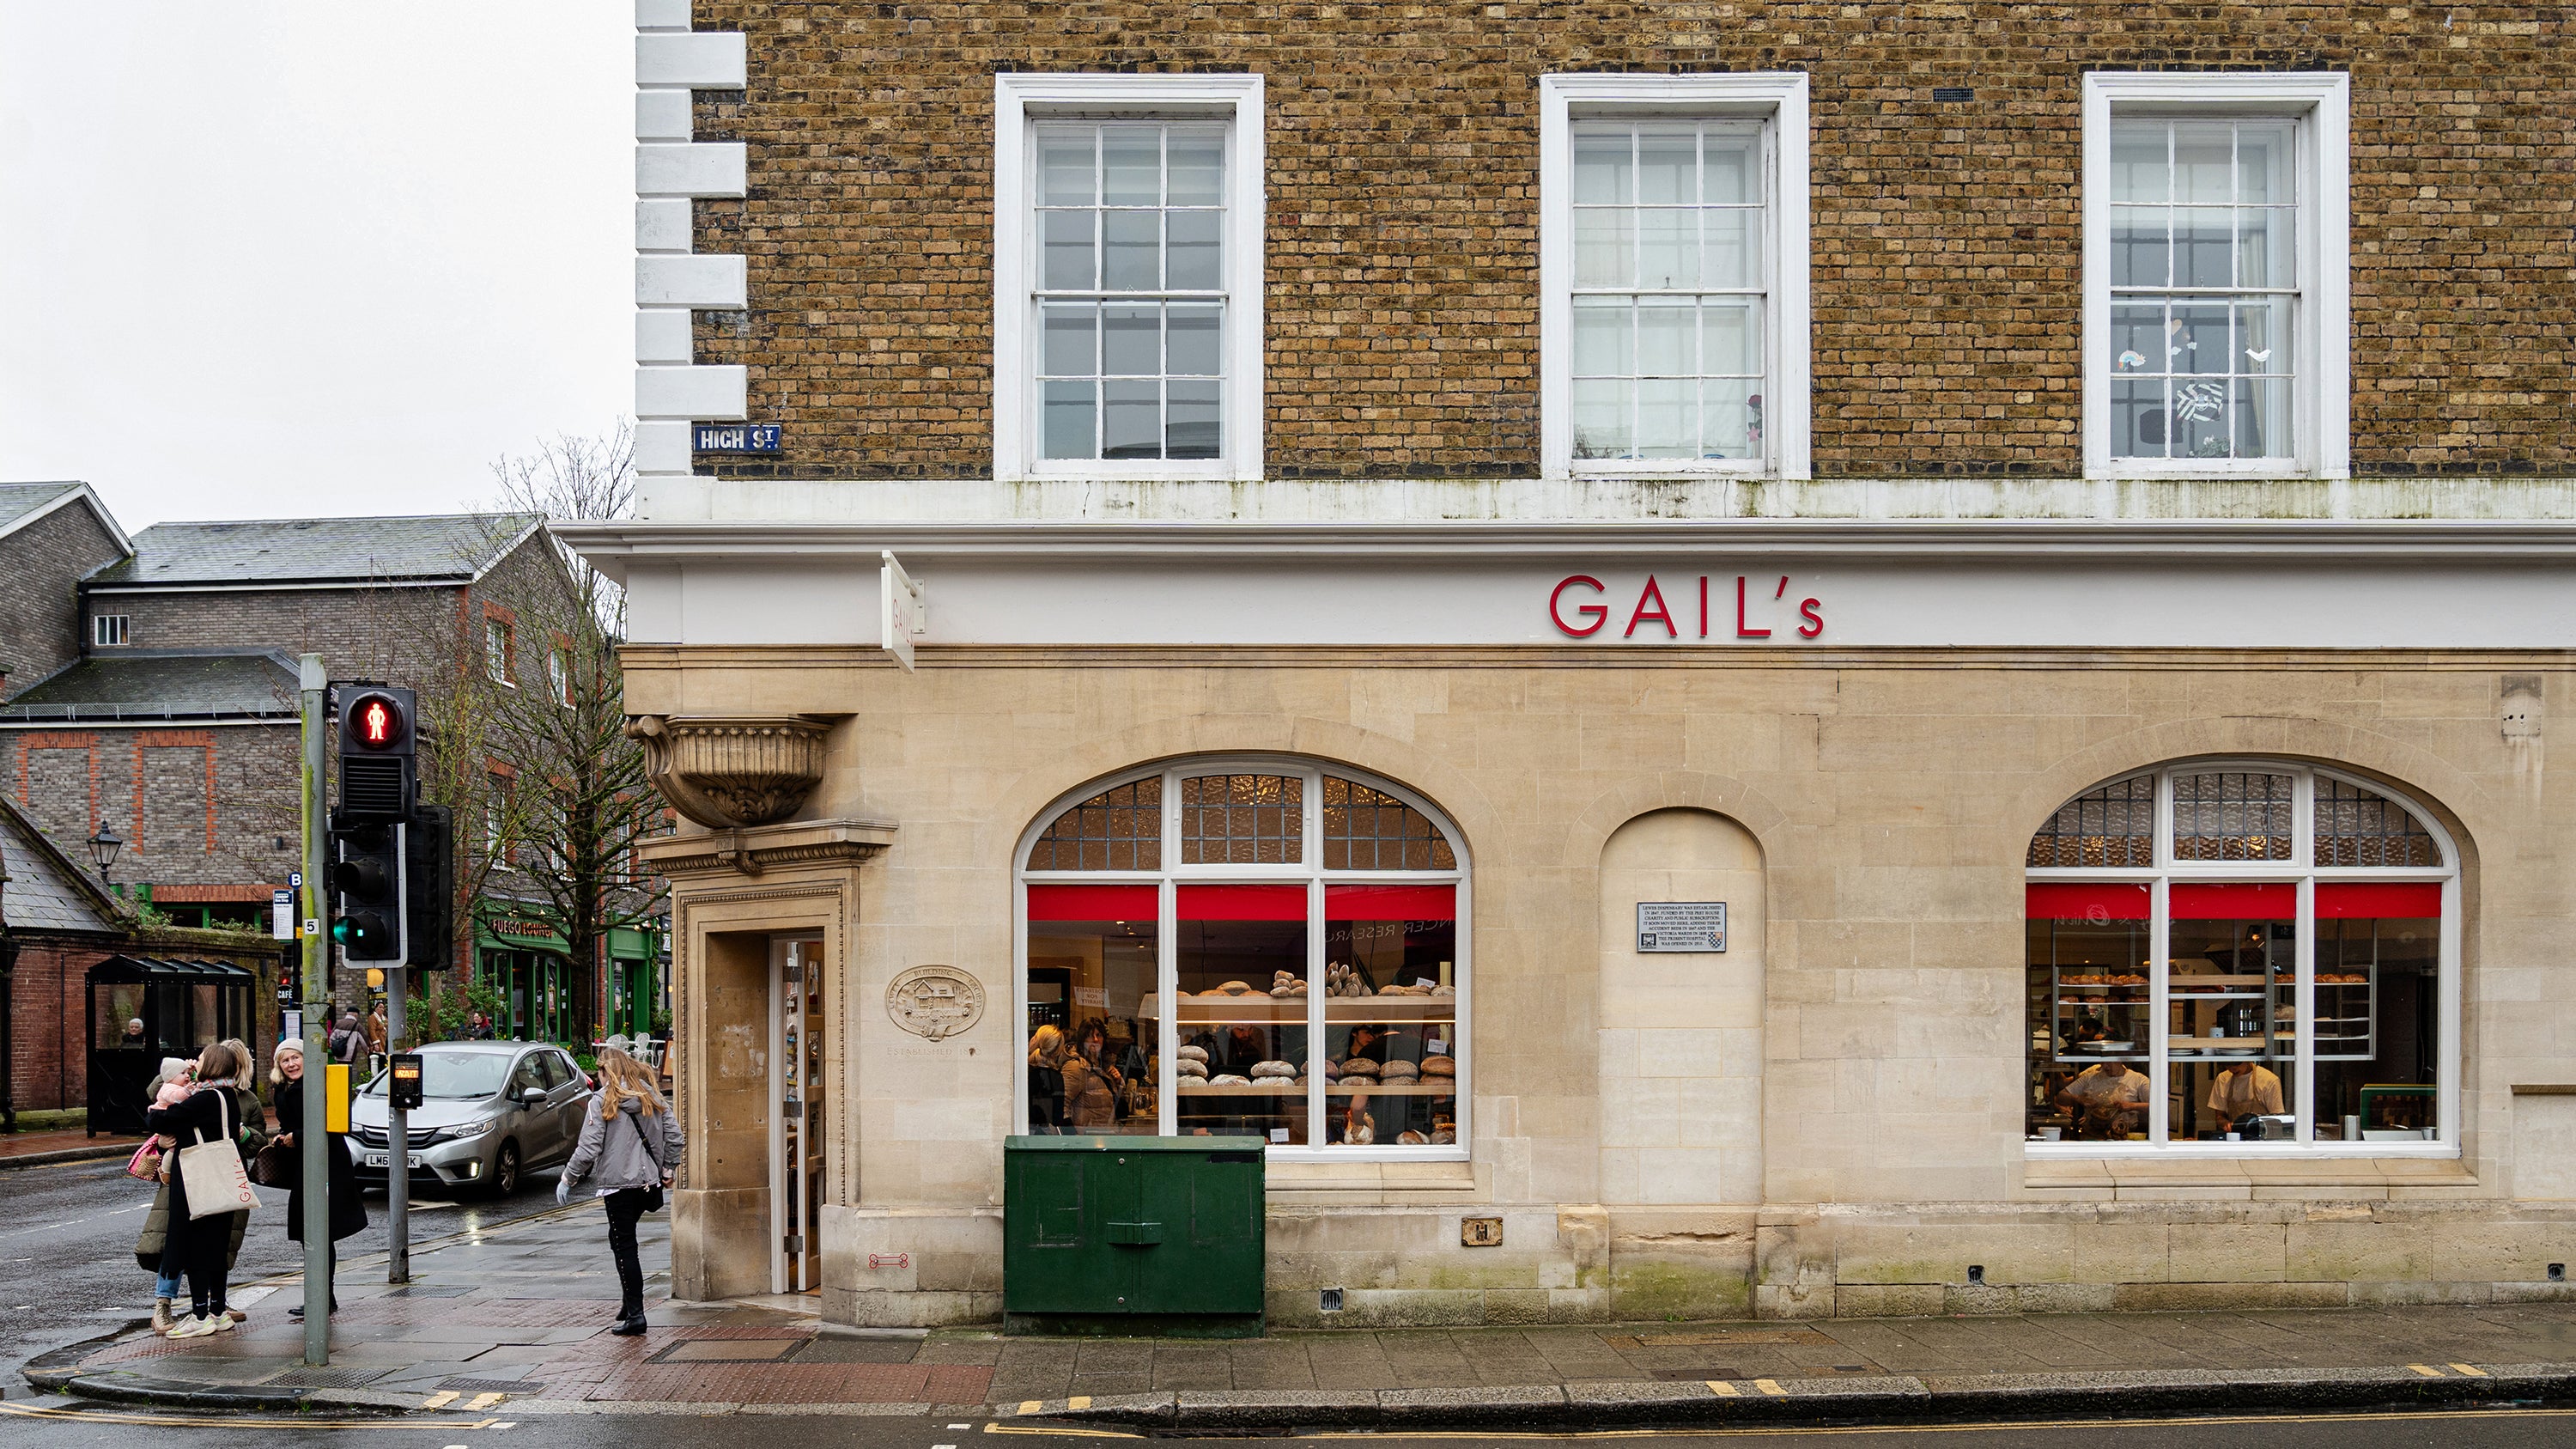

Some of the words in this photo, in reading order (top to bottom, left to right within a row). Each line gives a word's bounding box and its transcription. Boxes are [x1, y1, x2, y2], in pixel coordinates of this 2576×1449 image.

[701, 430, 744, 448] HIGH
[1549, 573, 1825, 638] GAIL's
[291, 874, 301, 886] B
[307, 921, 315, 932] 5
[492, 919, 521, 935] FUEGO
[913, 968, 953, 977] BUILDING
[277, 989, 293, 999] CAFÉ
[396, 1069, 416, 1079] WAIT
[1476, 1224, 1488, 1240] H
